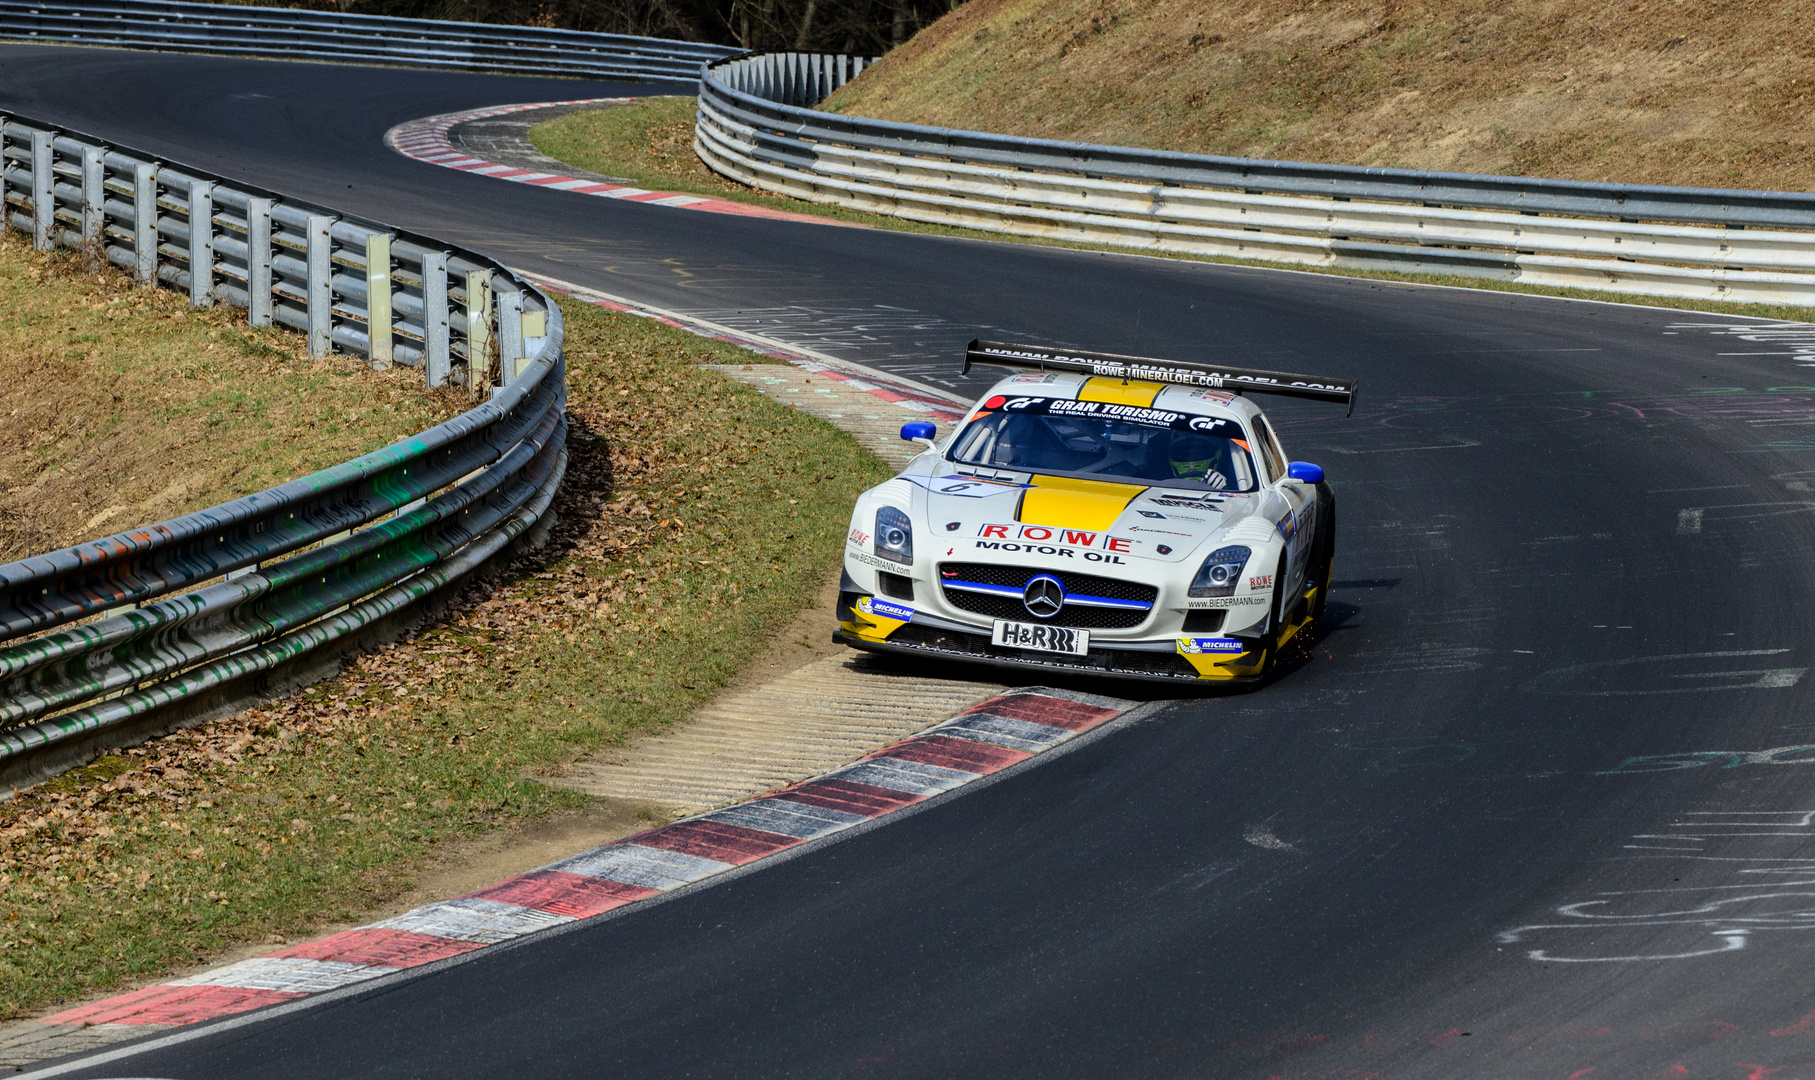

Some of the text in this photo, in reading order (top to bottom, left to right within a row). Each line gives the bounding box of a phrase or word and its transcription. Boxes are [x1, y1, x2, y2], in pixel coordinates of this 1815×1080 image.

[1093, 365, 1223, 388] ROWEMINERALOEL.COM
[1049, 400, 1100, 412] GRAN
[1087, 412, 1121, 420] DRIVING
[1122, 415, 1170, 427] SIMULATOR
[850, 529, 869, 543] ROWE
[978, 524, 1132, 553] ROWE
[975, 541, 1126, 565] MOTOR OIL
[849, 552, 911, 576] www.BIEDERMANN.com
[1250, 575, 1273, 587] ROWE
[1188, 597, 1266, 608] www.BIEDERMANN.com
[874, 603, 913, 617] MICHELIN
[1202, 641, 1243, 649] MICHELIN
